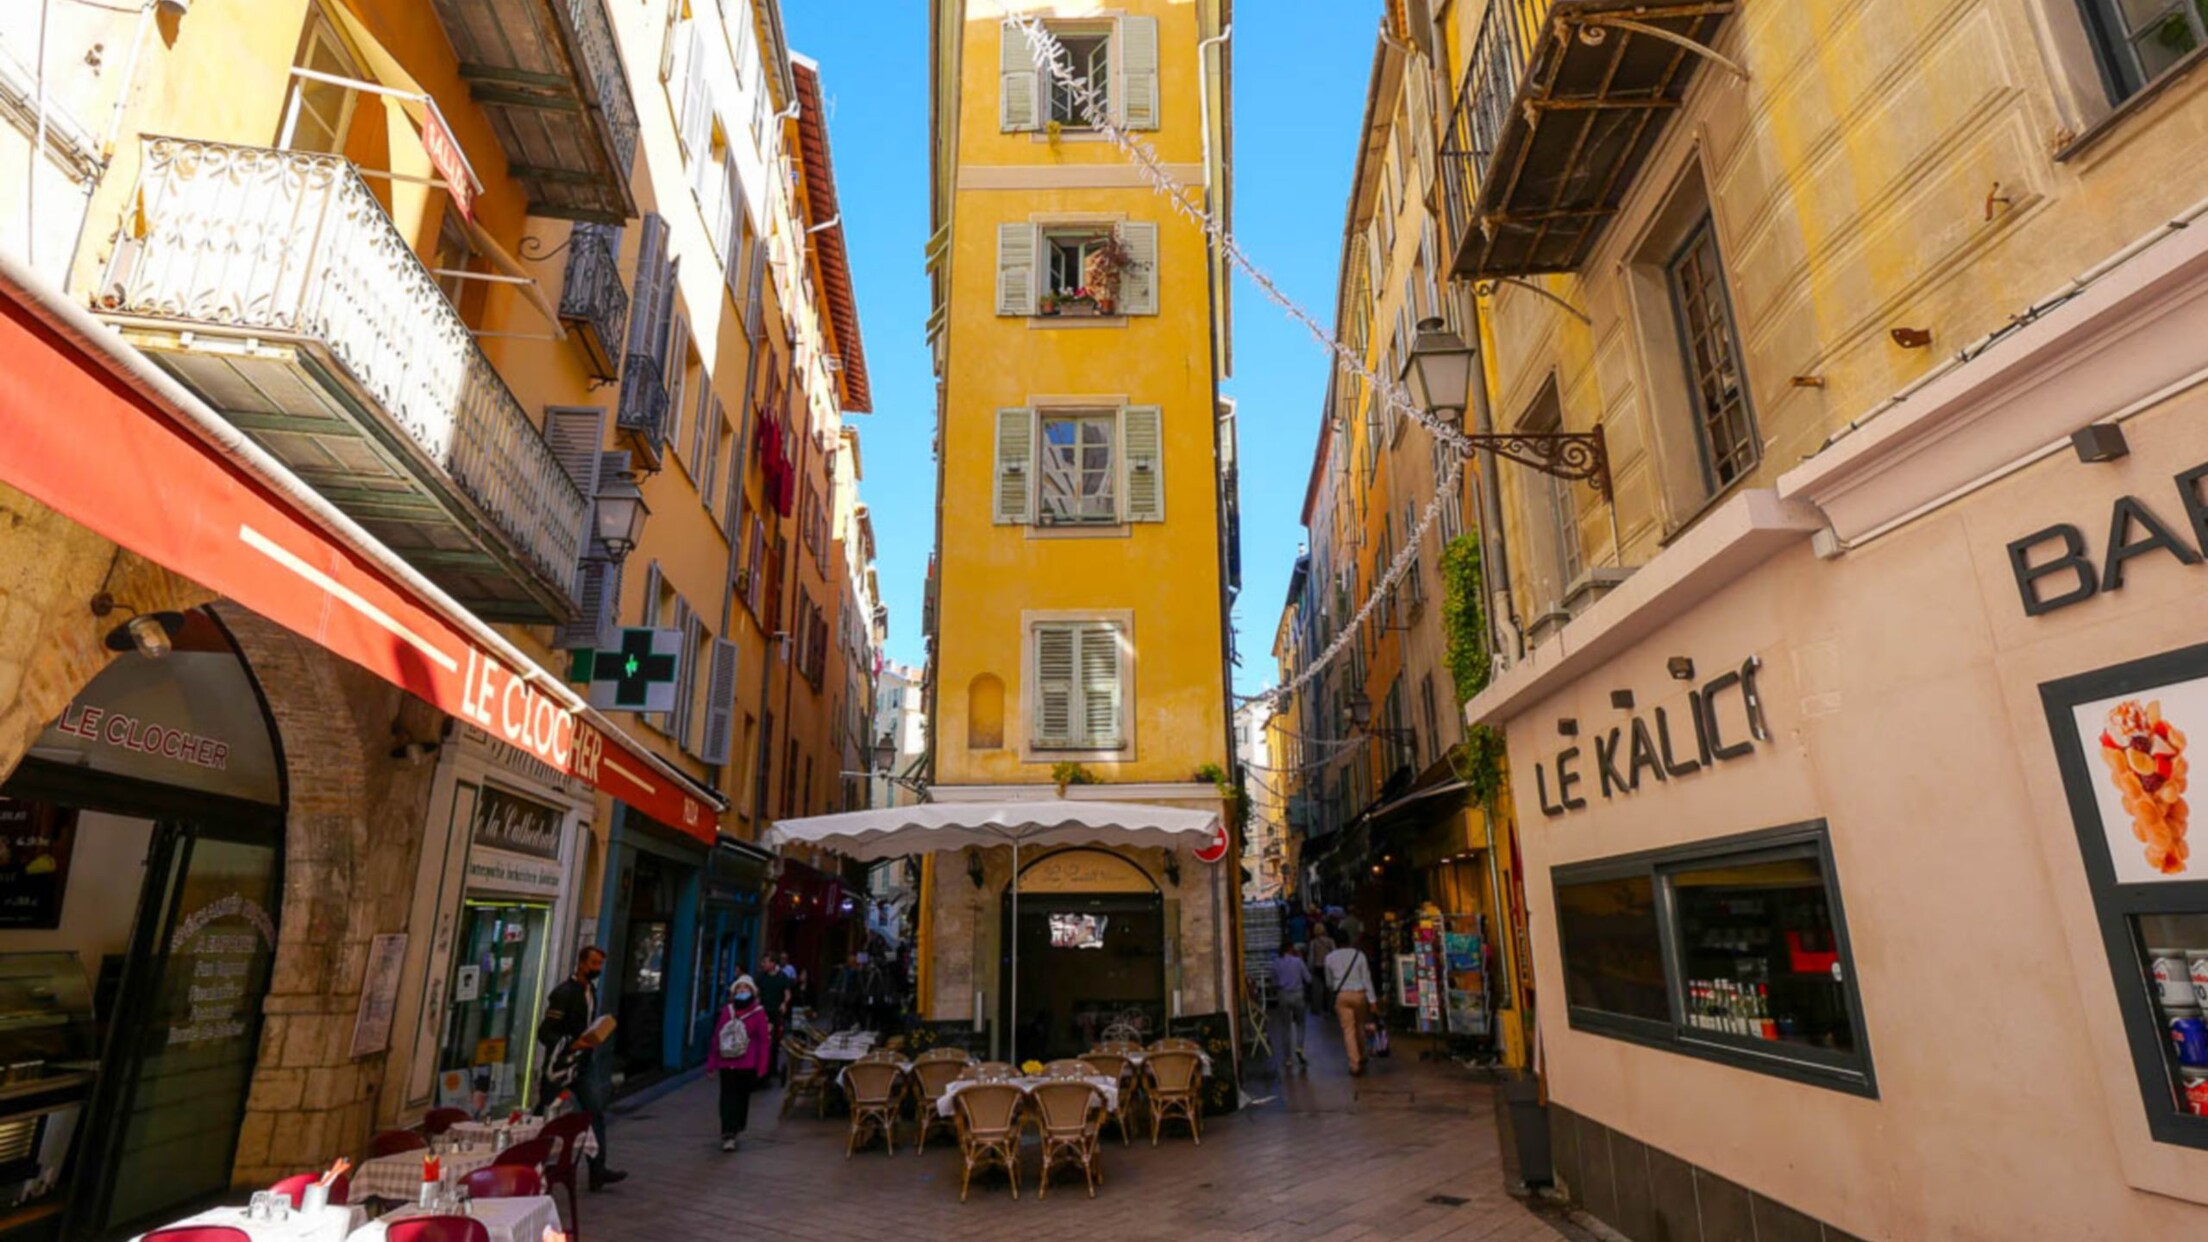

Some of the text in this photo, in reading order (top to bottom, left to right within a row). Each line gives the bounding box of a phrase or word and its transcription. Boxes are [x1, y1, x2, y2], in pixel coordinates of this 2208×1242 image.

[57, 703, 230, 770] LE CLOCHER
[461, 643, 499, 727] LE
[503, 674, 602, 784] CLOCHER
[1535, 746, 1587, 817] LE
